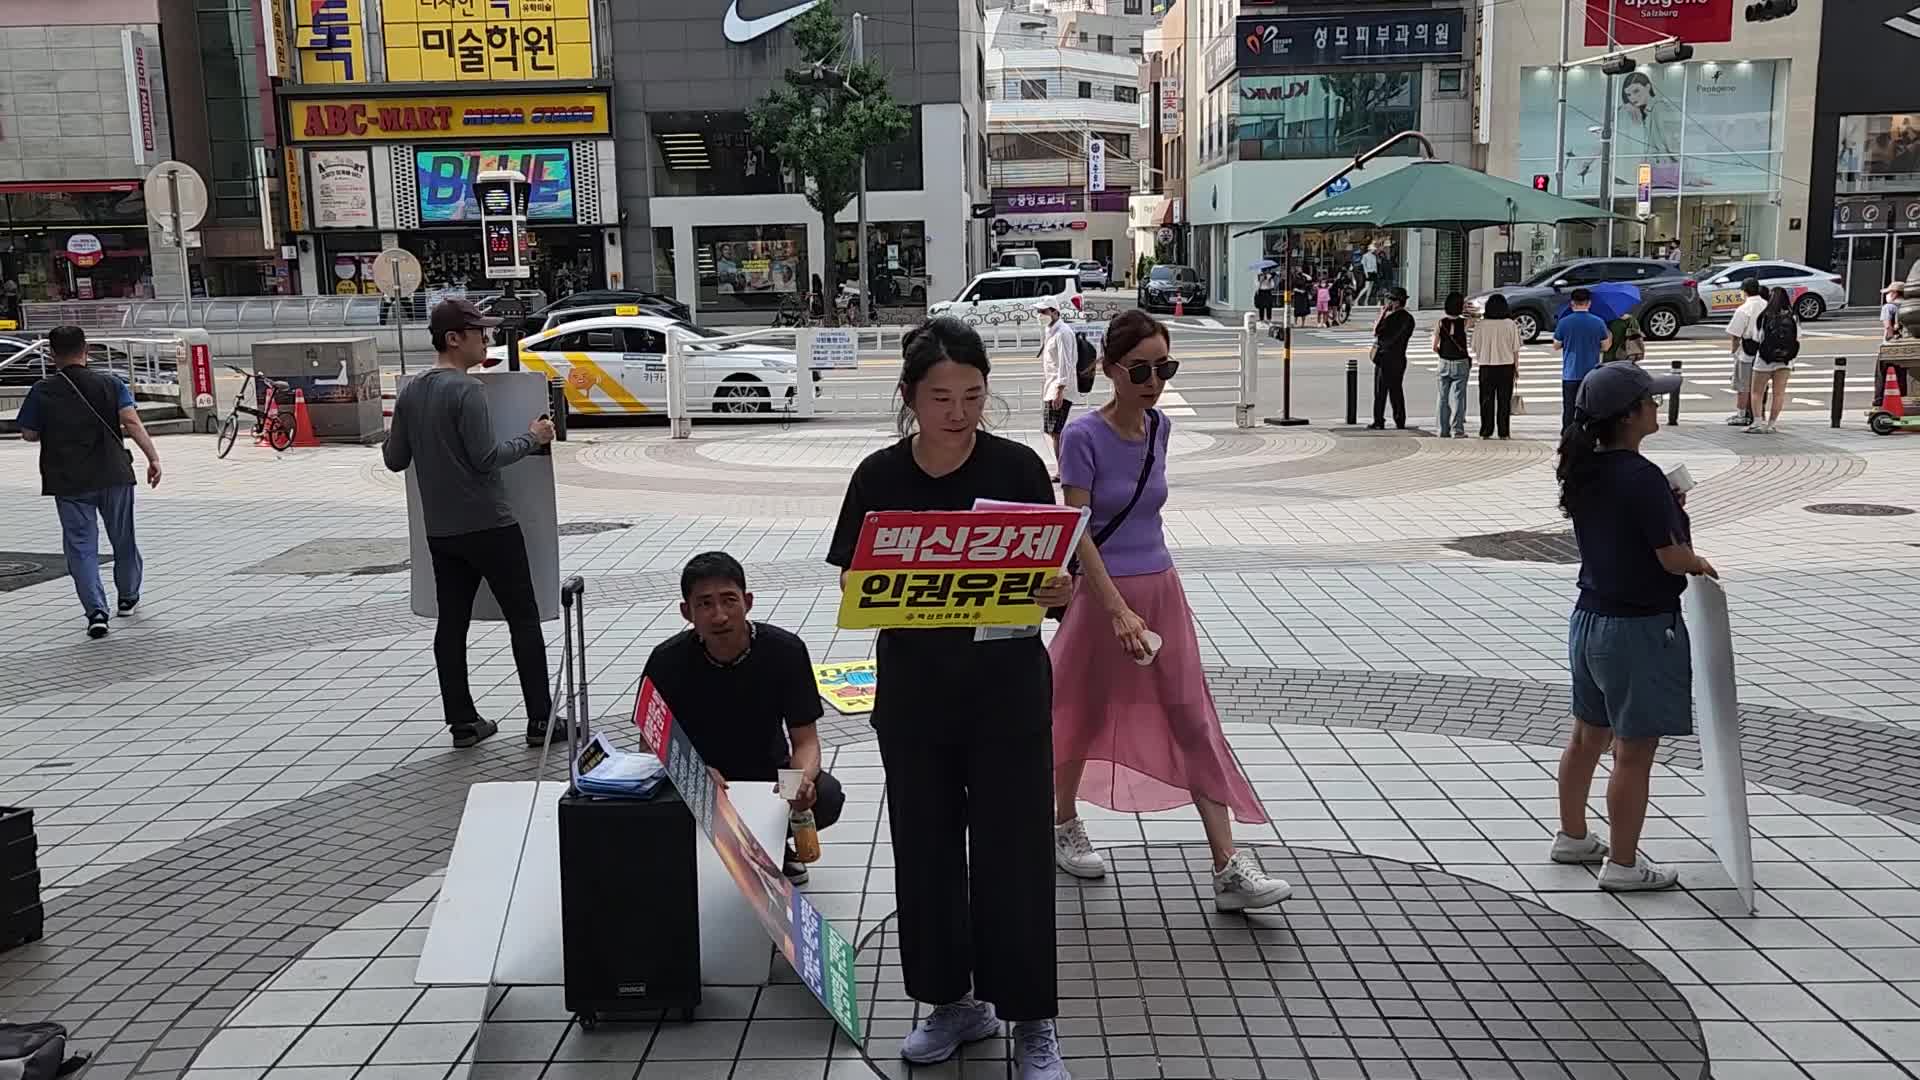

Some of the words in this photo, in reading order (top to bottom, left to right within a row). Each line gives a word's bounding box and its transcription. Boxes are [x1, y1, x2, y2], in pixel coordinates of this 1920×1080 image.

[1640, 9, 1679, 17] Salzburg
[421, 25, 555, 73] 미술학원
[135, 47, 147, 90] SHOE
[303, 103, 453, 137] ABC-MART
[643, 372, 665, 384] 카카
[871, 524, 1065, 563] 백신강제
[858, 571, 1047, 609] 인권유린
